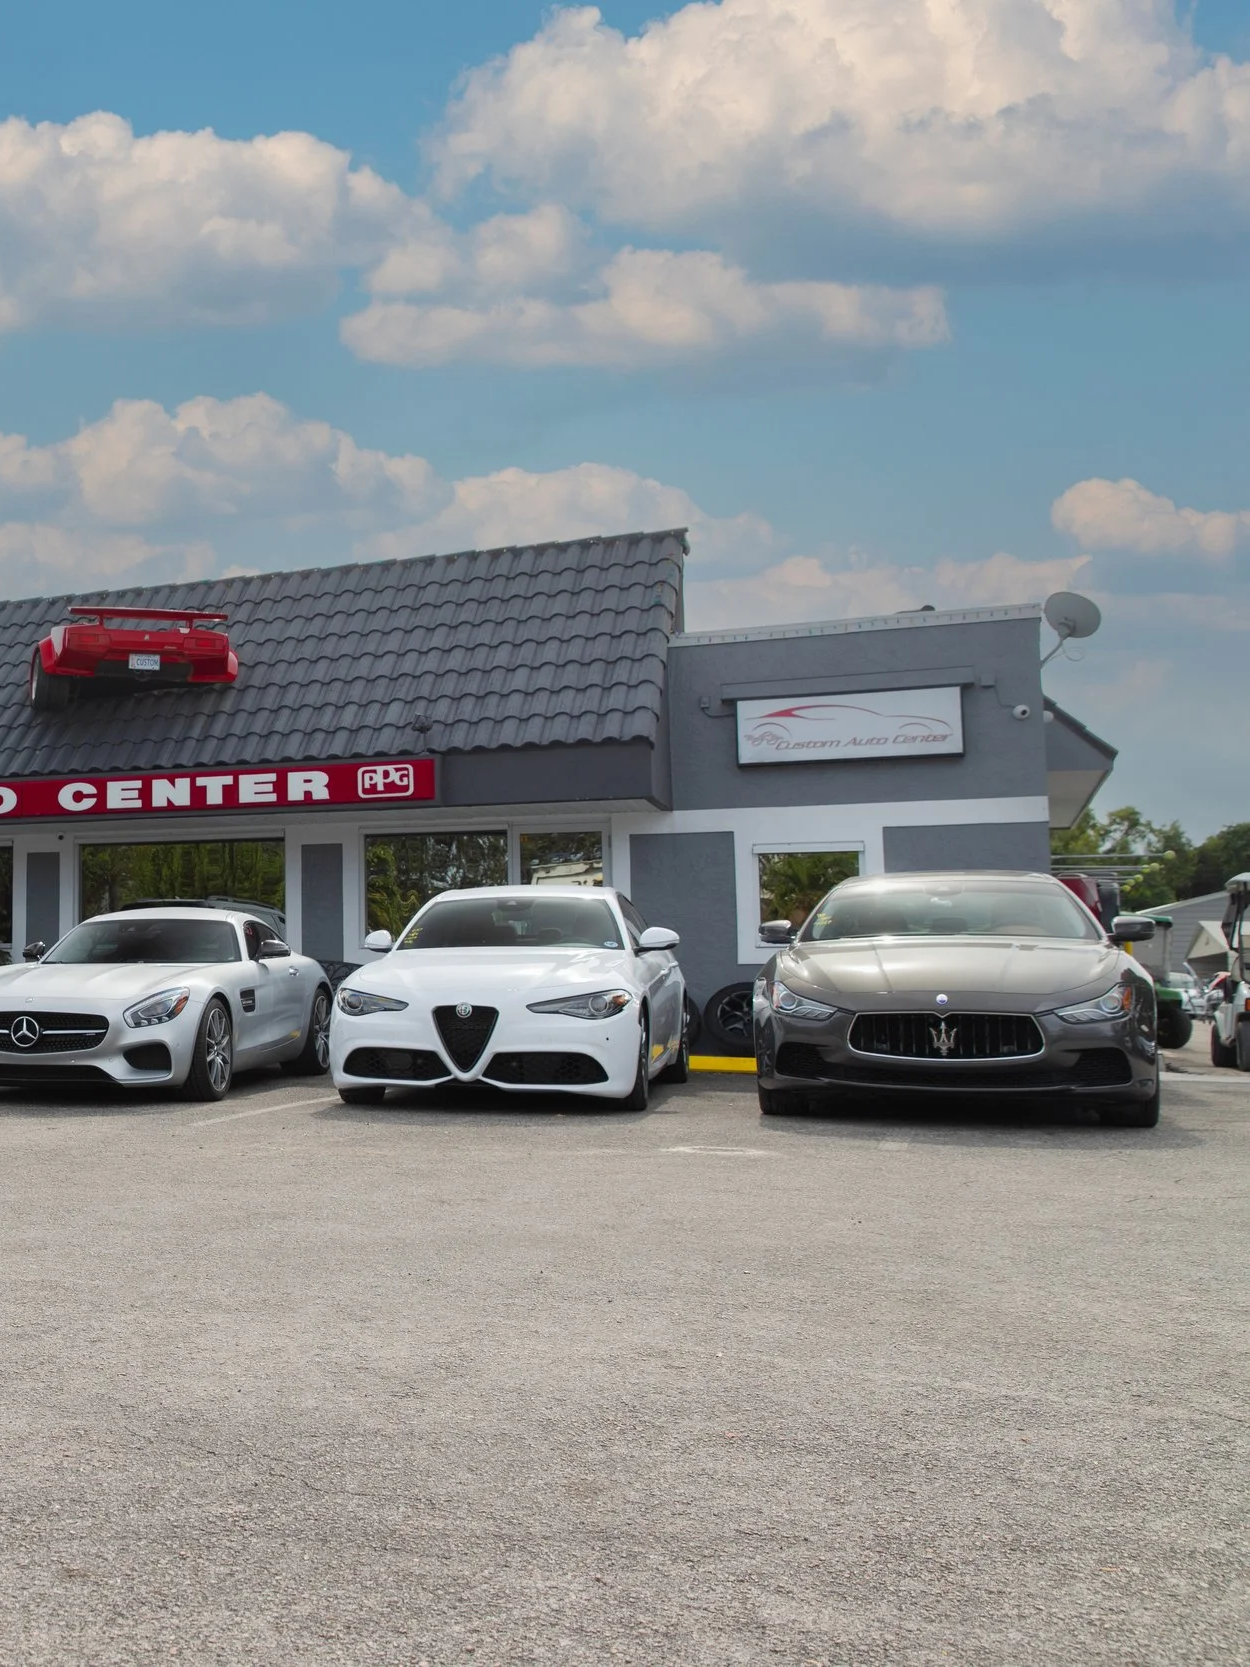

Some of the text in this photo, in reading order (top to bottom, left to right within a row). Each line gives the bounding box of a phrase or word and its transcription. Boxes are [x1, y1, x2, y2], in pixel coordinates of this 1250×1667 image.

[136, 658, 159, 666] CUSTOM
[843, 736, 888, 747] Auto
[892, 733, 953, 744] Center
[362, 766, 410, 792] PPG
[57, 770, 330, 811] CENTER
